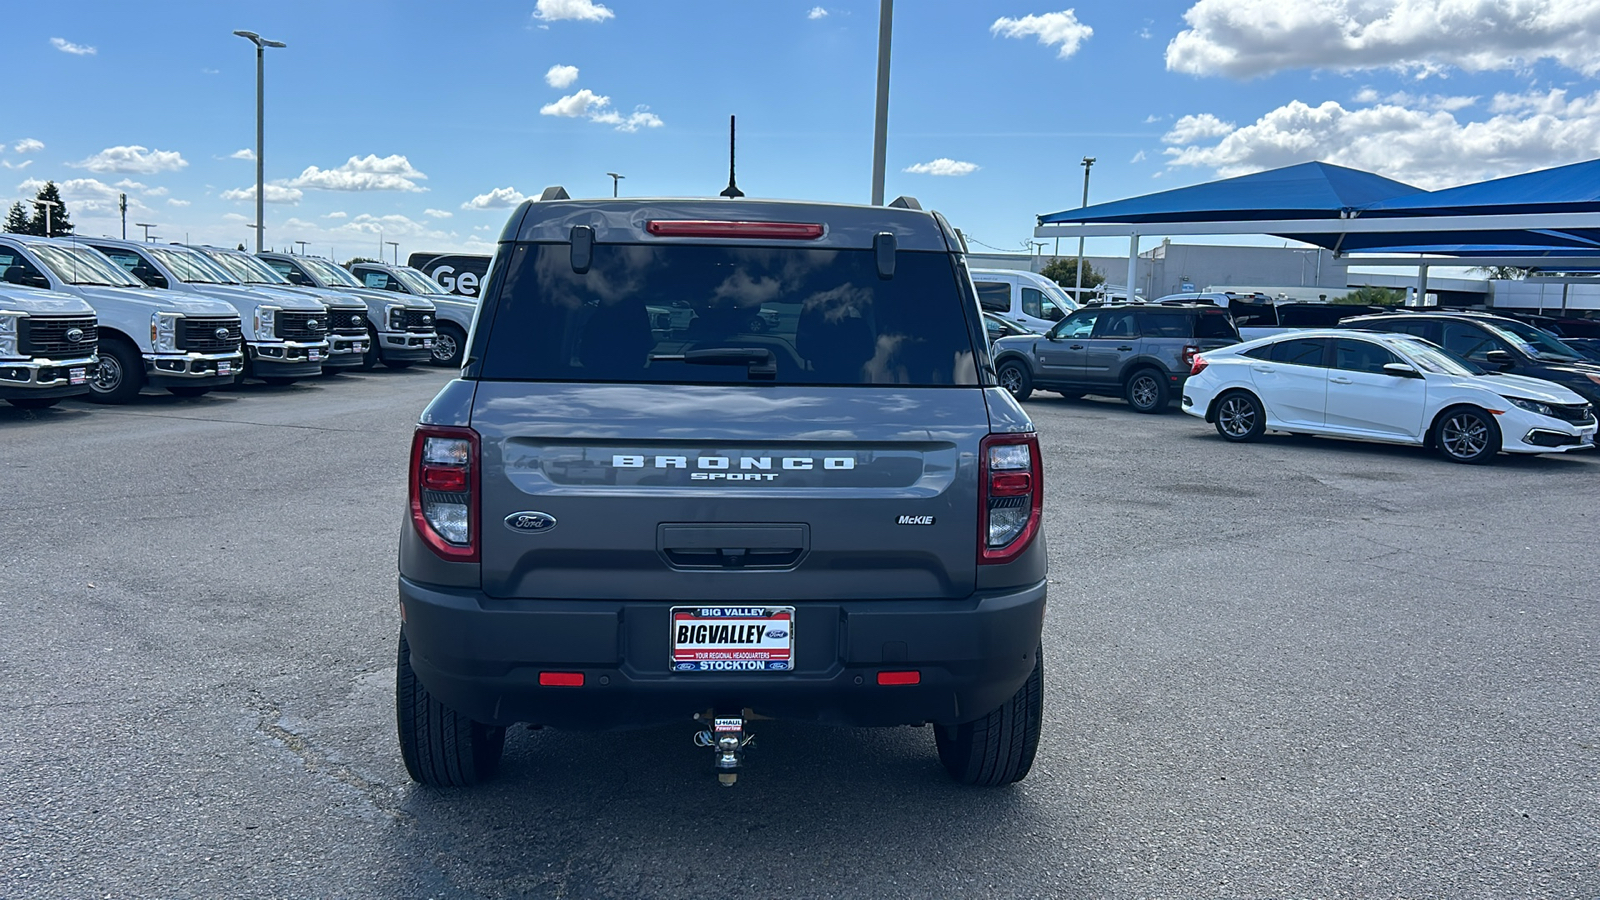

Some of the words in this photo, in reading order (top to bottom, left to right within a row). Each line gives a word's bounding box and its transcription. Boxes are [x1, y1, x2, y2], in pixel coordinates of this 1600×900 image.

[612, 455, 855, 470] BRONCO
[690, 472, 779, 481] SPORT
[515, 515, 544, 528] Ford
[898, 515, 934, 525] McKIE
[701, 608, 721, 616] BIG
[724, 608, 765, 616] VALLEY
[676, 624, 767, 644] BIGVALLEY
[732, 652, 770, 660] HEADQUARTERS
[700, 661, 765, 670] STOCKTON
